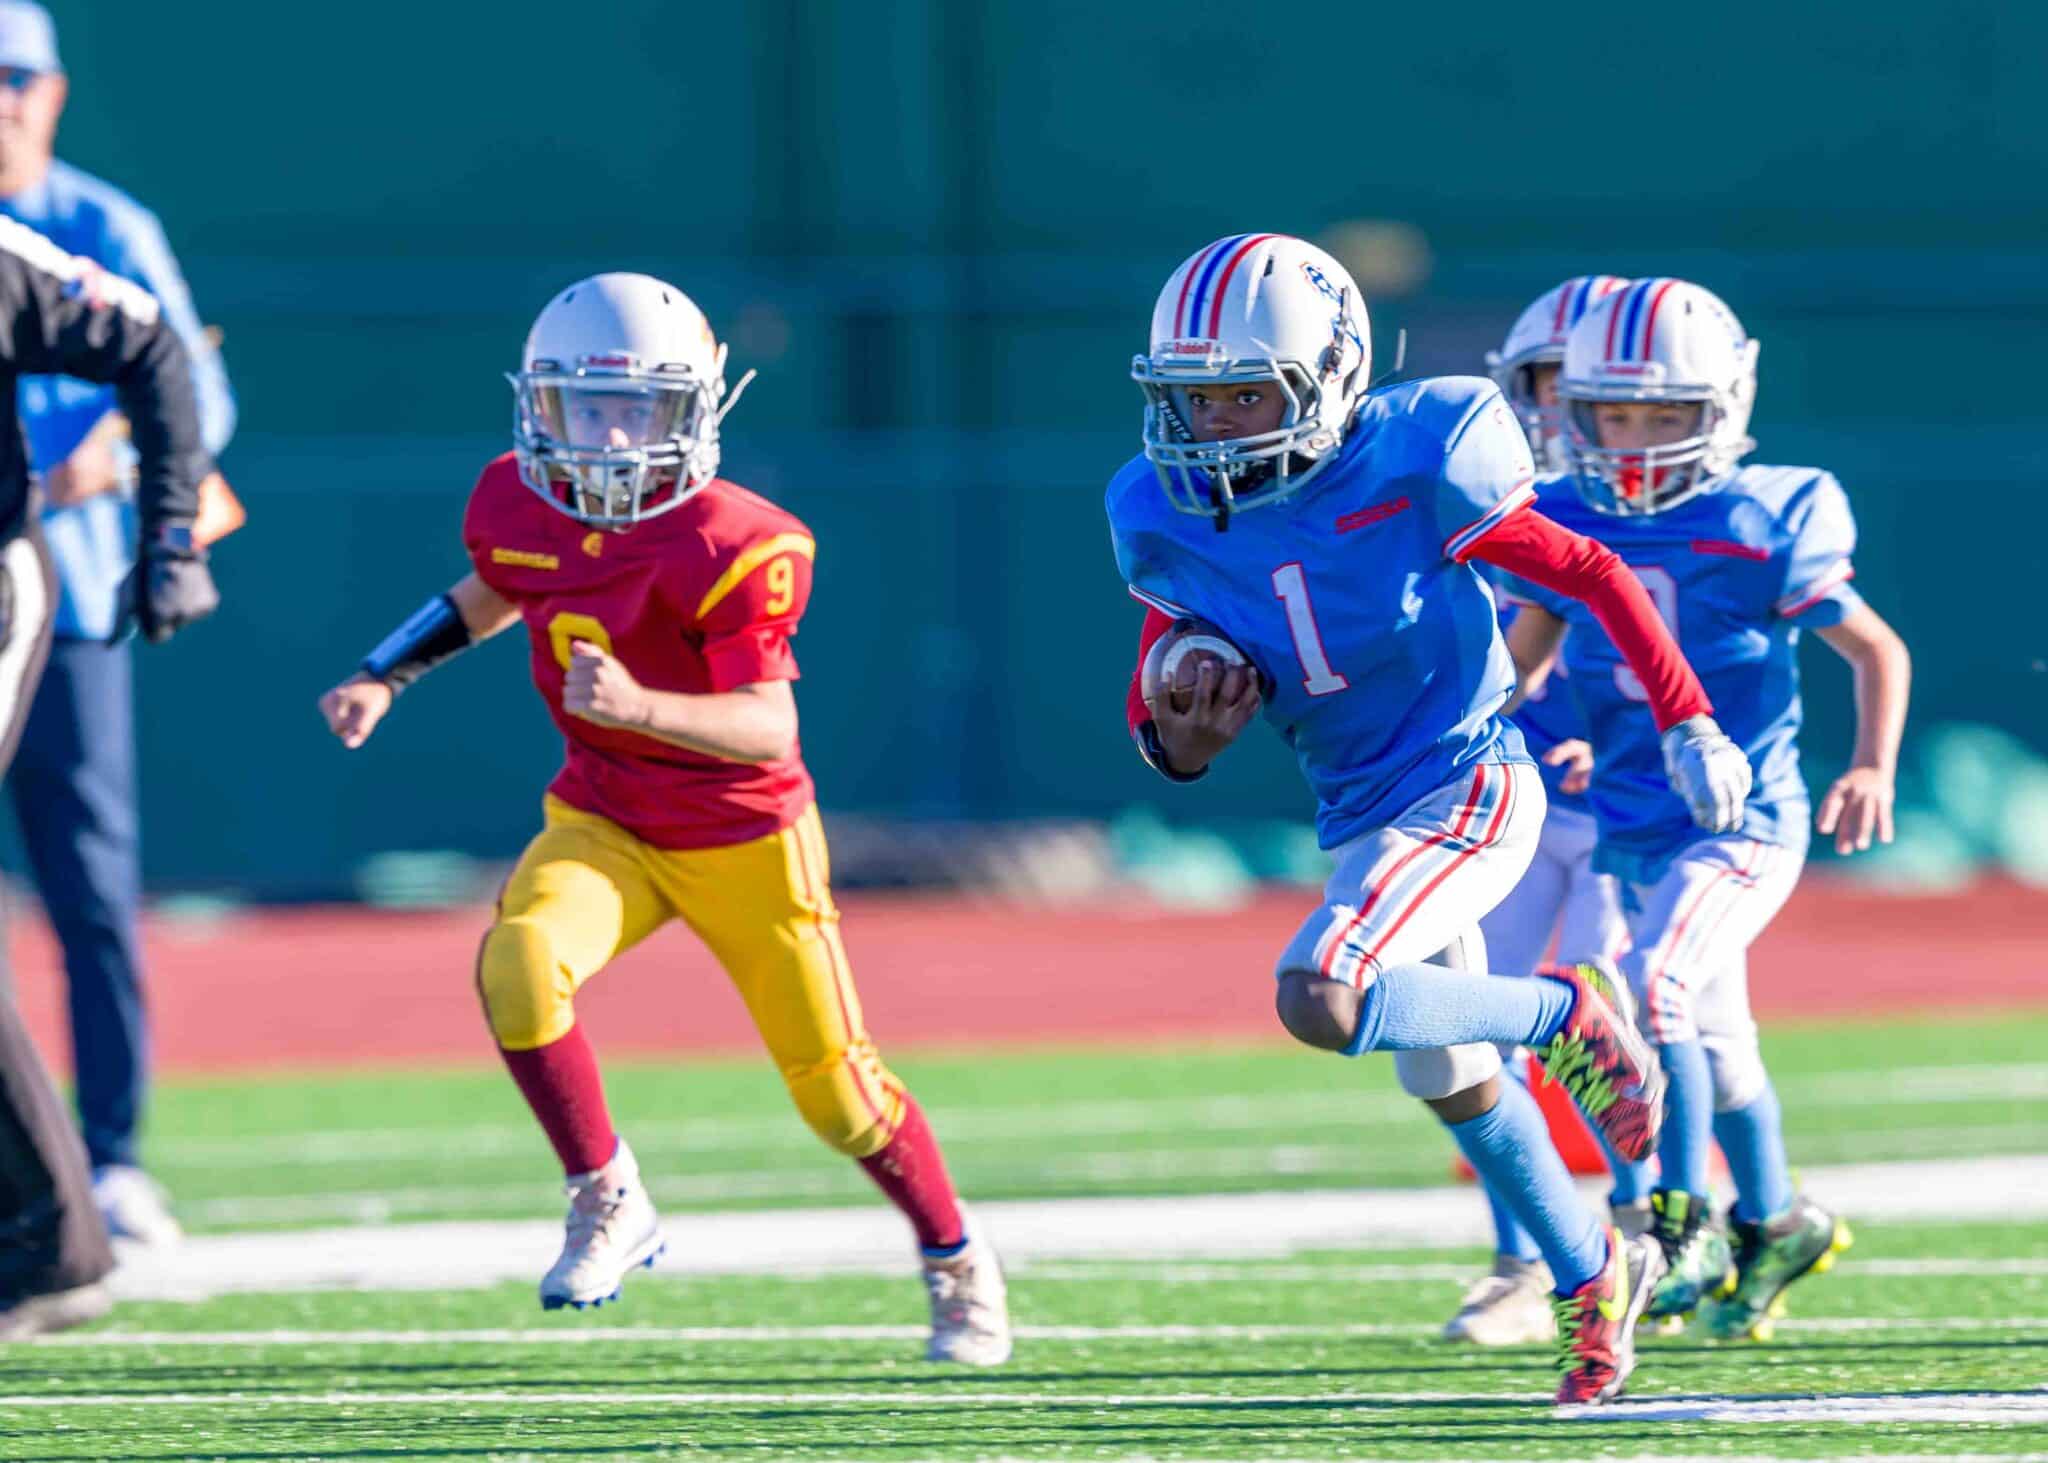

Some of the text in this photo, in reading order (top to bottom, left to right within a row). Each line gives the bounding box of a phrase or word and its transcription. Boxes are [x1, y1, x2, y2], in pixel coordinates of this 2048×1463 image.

[1174, 341, 1212, 354] Riddell
[766, 555, 795, 617] 9
[1271, 560, 1351, 697] 1
